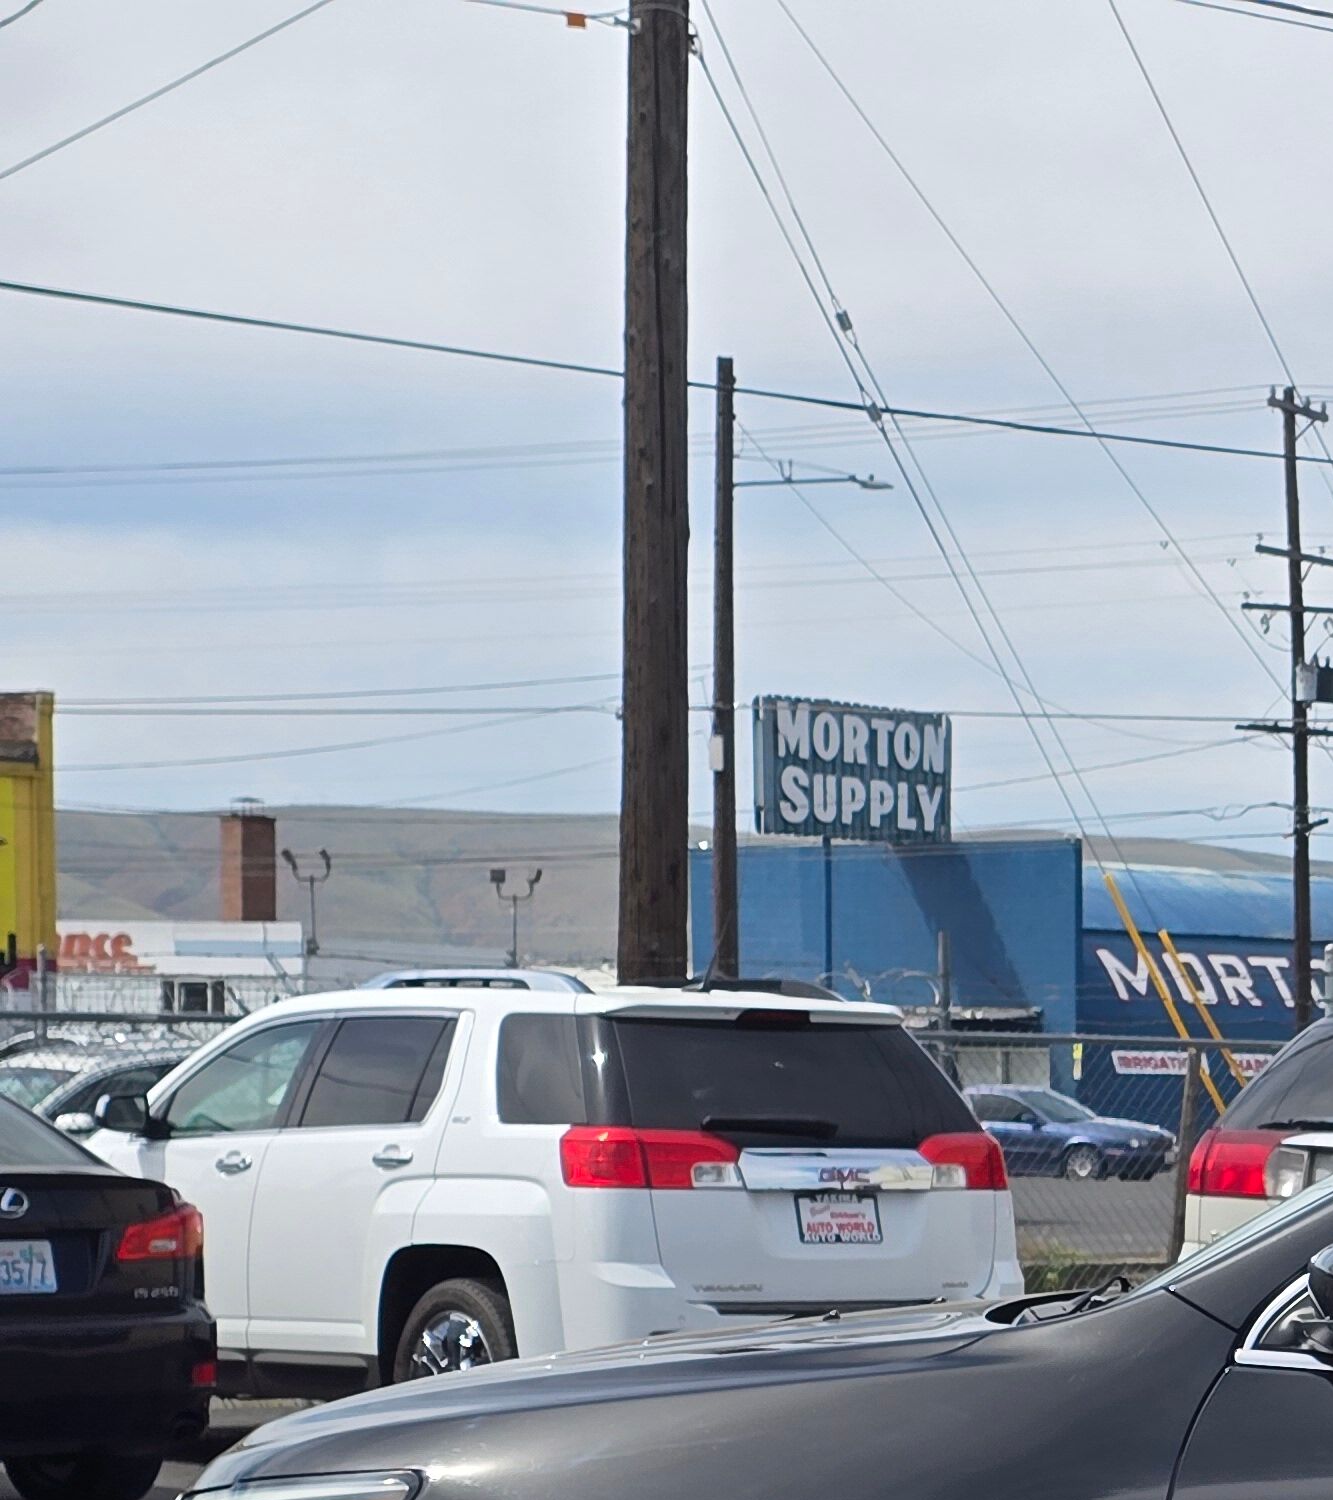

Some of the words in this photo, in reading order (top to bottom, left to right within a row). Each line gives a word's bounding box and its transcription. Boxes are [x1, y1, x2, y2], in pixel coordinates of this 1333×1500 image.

[777, 701, 947, 774] MORTON
[779, 765, 943, 832] SUPPLY
[818, 1168, 870, 1182] GMC
[807, 1222, 833, 1233] AUTO
[836, 1221, 875, 1233] WORLD
